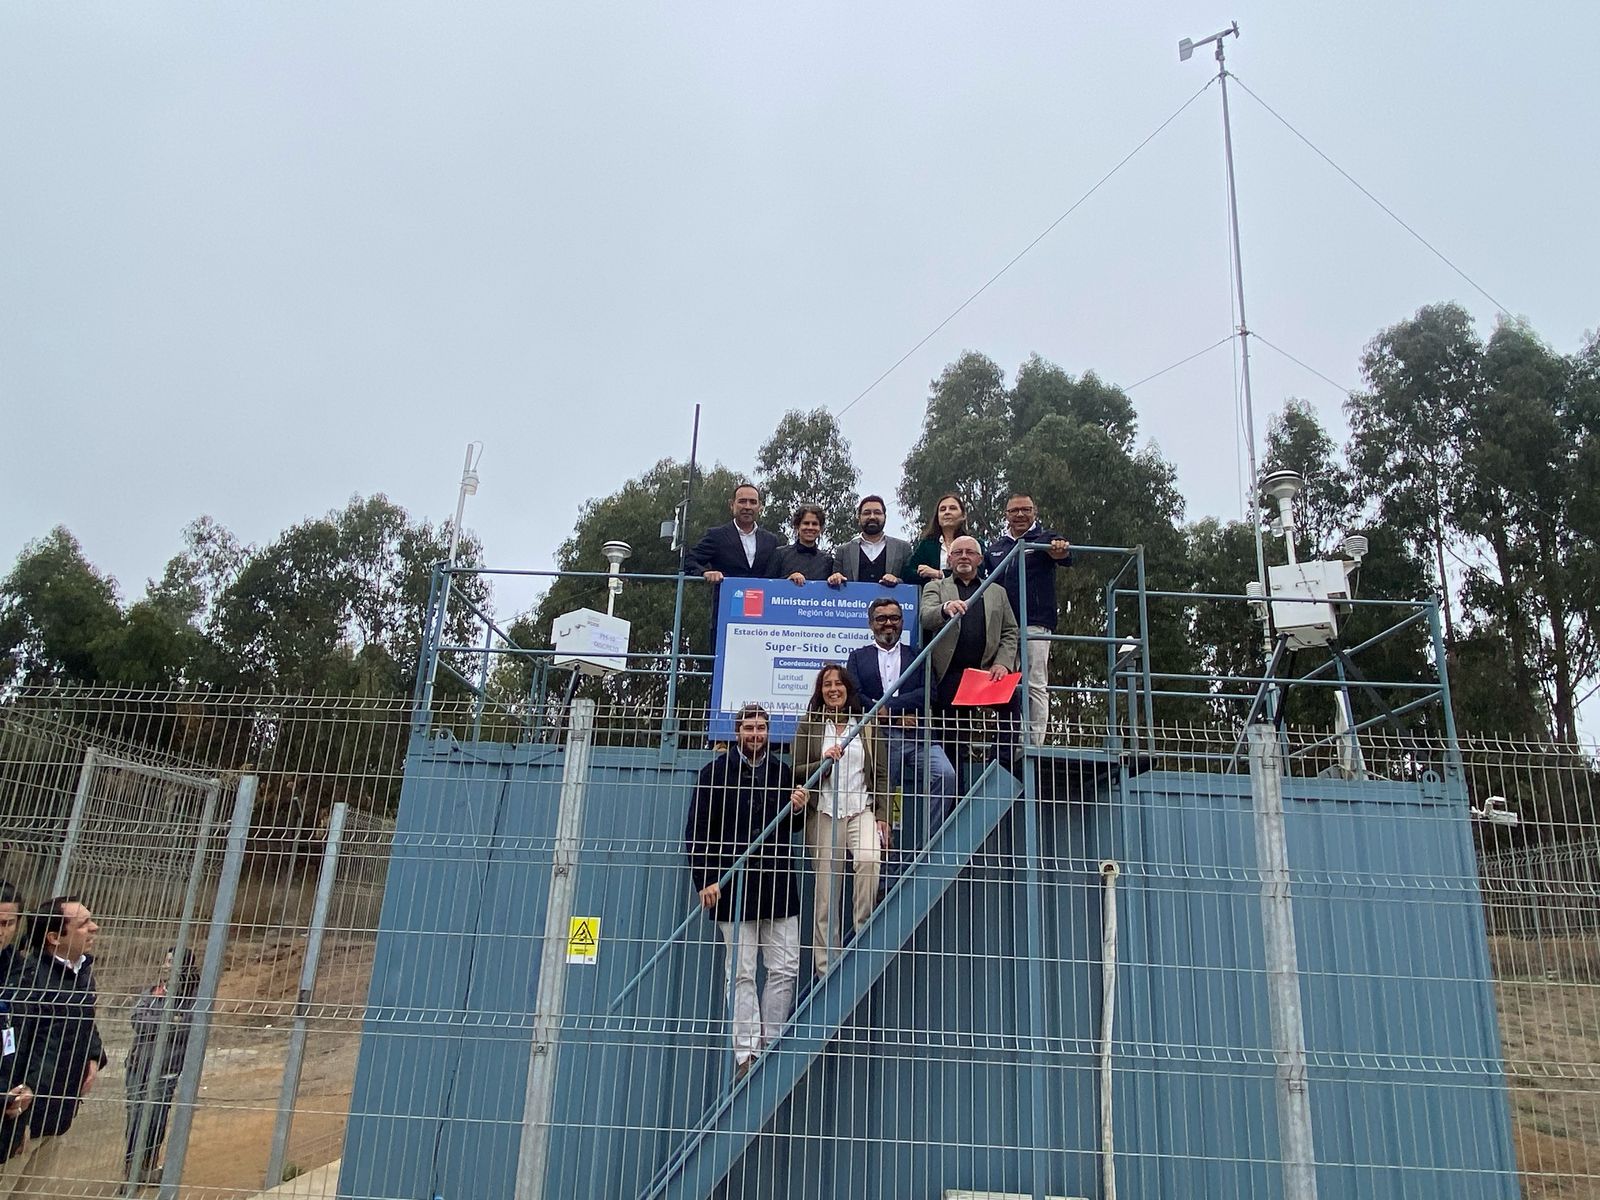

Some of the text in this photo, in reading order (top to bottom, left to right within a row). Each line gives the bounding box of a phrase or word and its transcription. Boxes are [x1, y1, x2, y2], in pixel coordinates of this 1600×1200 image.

[771, 596, 819, 607] Ministerio
[821, 598, 836, 608] del
[838, 599, 867, 609] Medio
[797, 609, 823, 618] Región
[835, 610, 869, 619] Valparaís
[733, 628, 768, 637] Estación
[781, 630, 825, 639] Monitoreo
[826, 631, 836, 639] de
[837, 632, 869, 640] Calidad
[765, 641, 855, 654] Super-Sitio Con
[778, 659, 821, 668] Coordenadas
[778, 673, 804, 681] Latitud
[777, 682, 809, 691] Longitud
